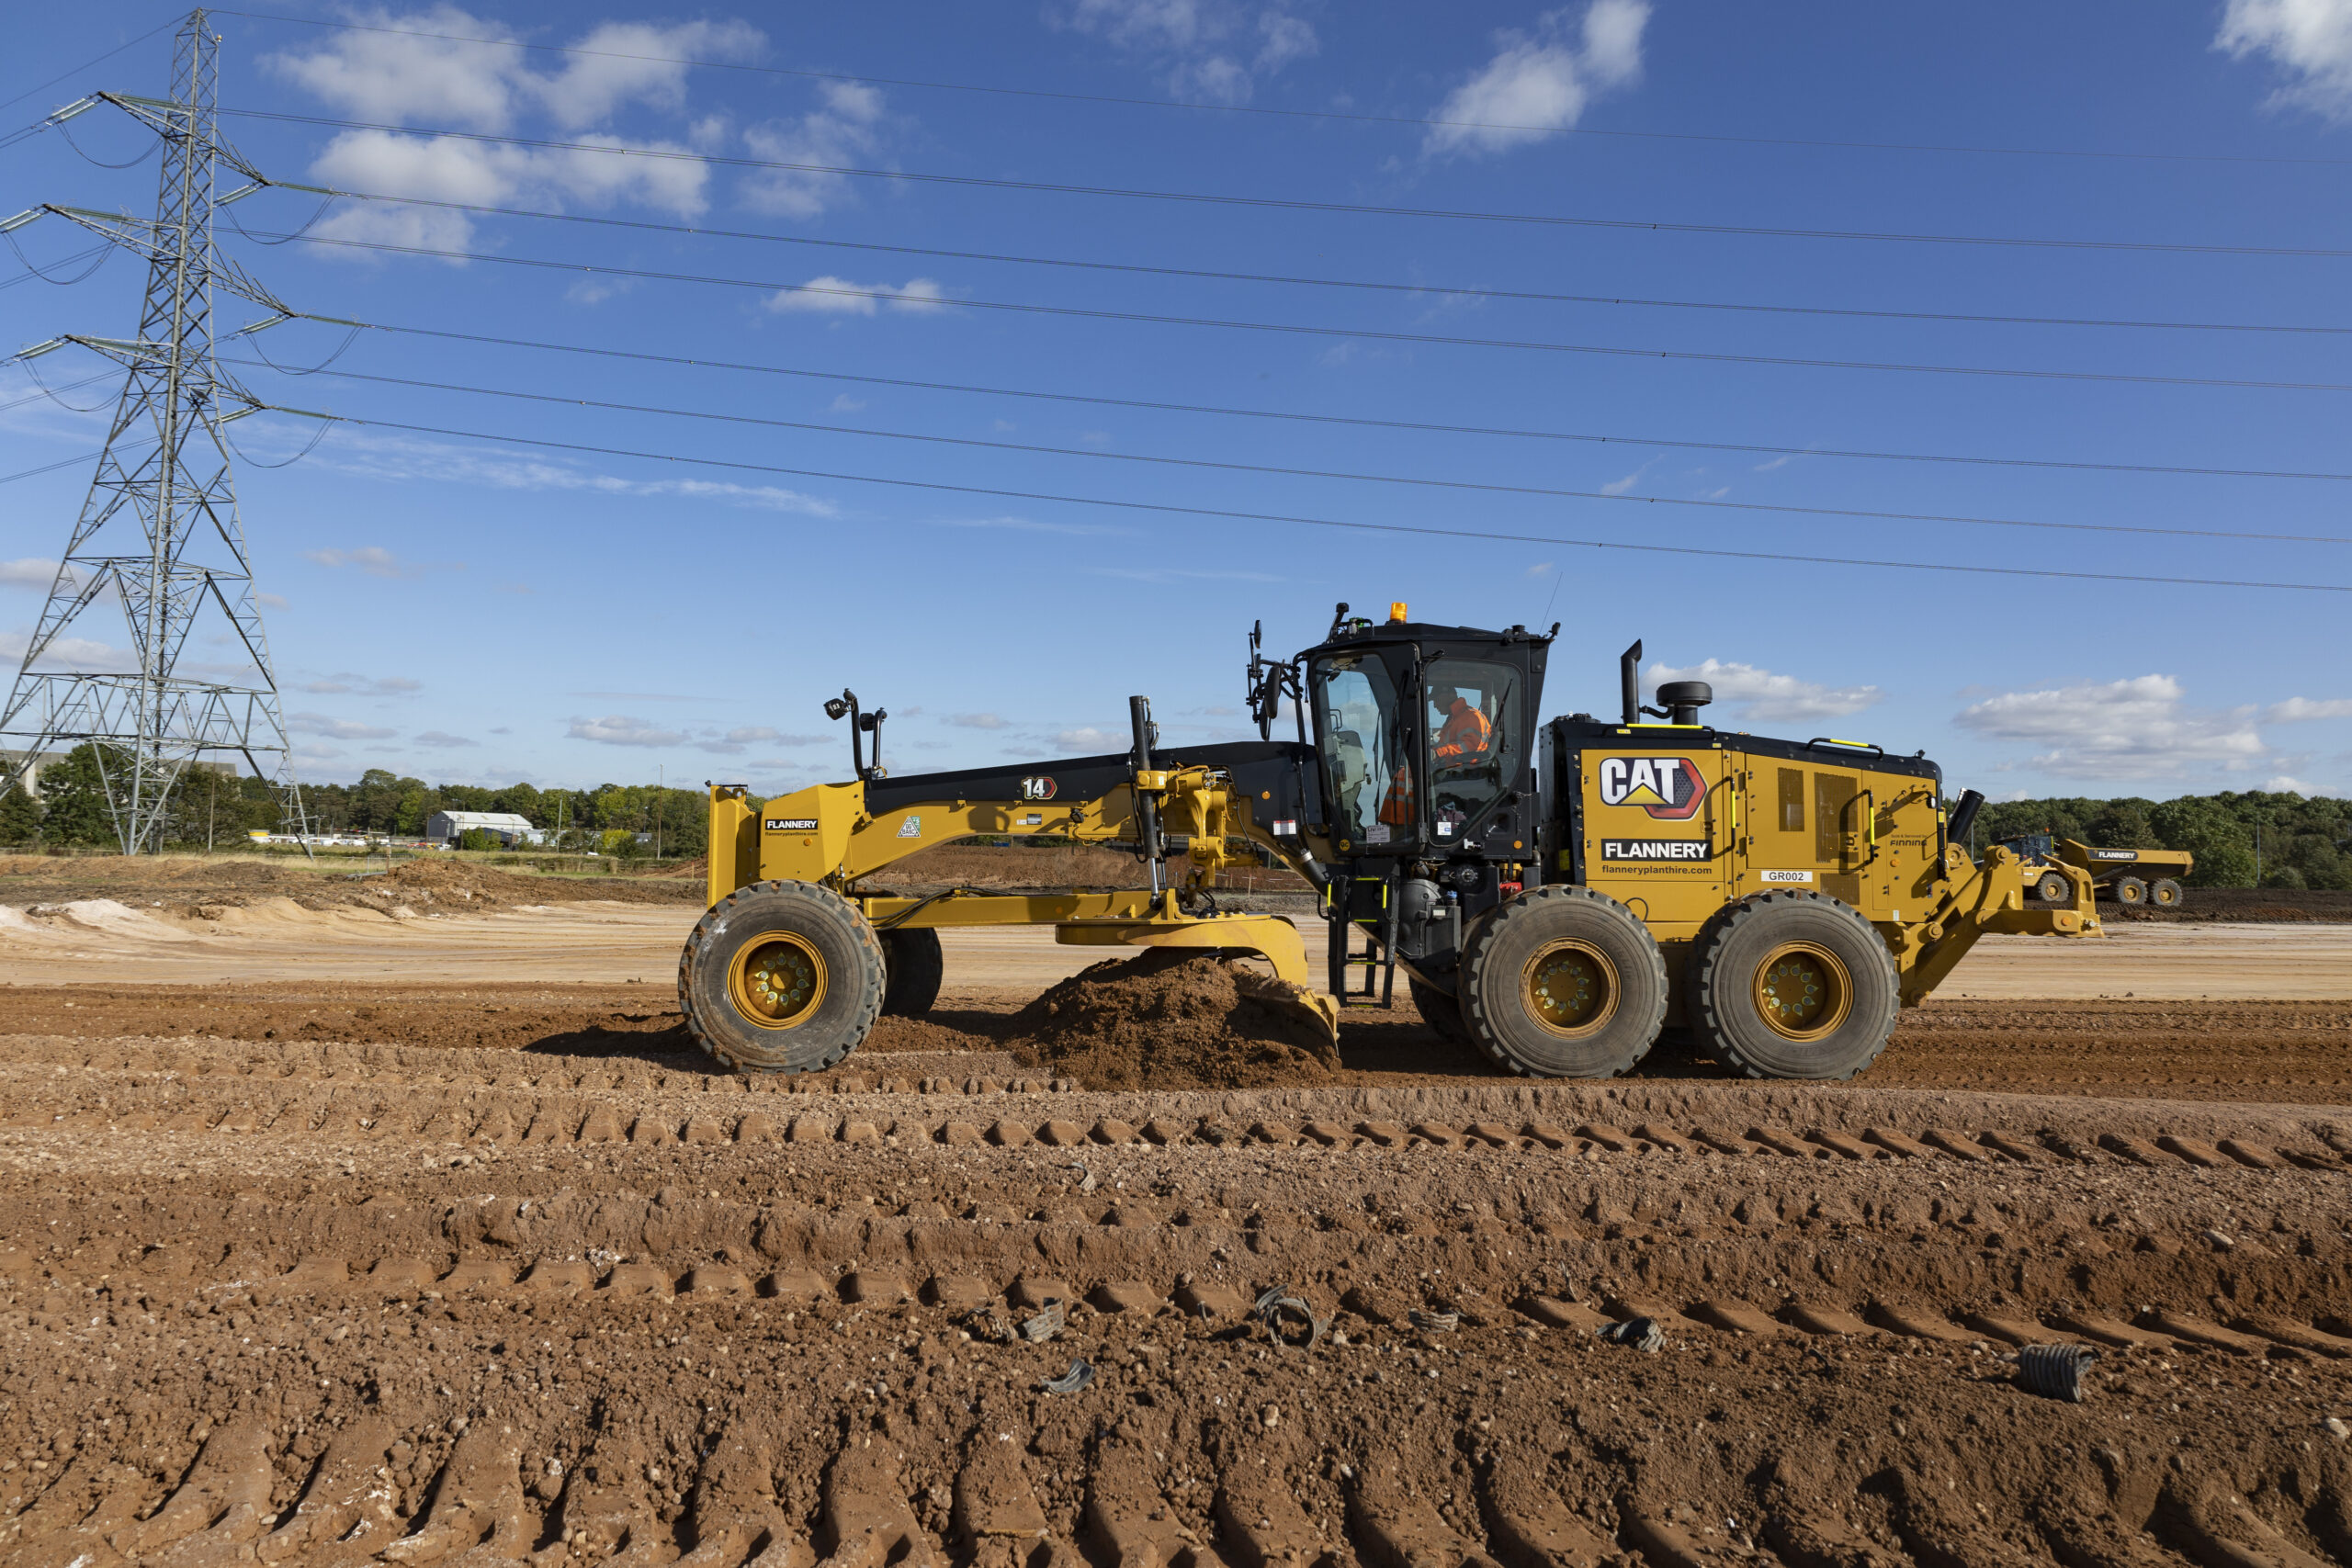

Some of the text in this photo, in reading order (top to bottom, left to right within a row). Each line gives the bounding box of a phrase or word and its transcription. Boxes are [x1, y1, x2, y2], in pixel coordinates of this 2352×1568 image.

[1023, 778, 1046, 797] 14
[1600, 758, 1680, 805] CAT
[766, 820, 817, 829] FLANNERY
[1605, 842, 1709, 859] FLANNERY
[1601, 865, 1713, 875] flanneryplanthire.com
[1769, 872, 1804, 881] GR002
